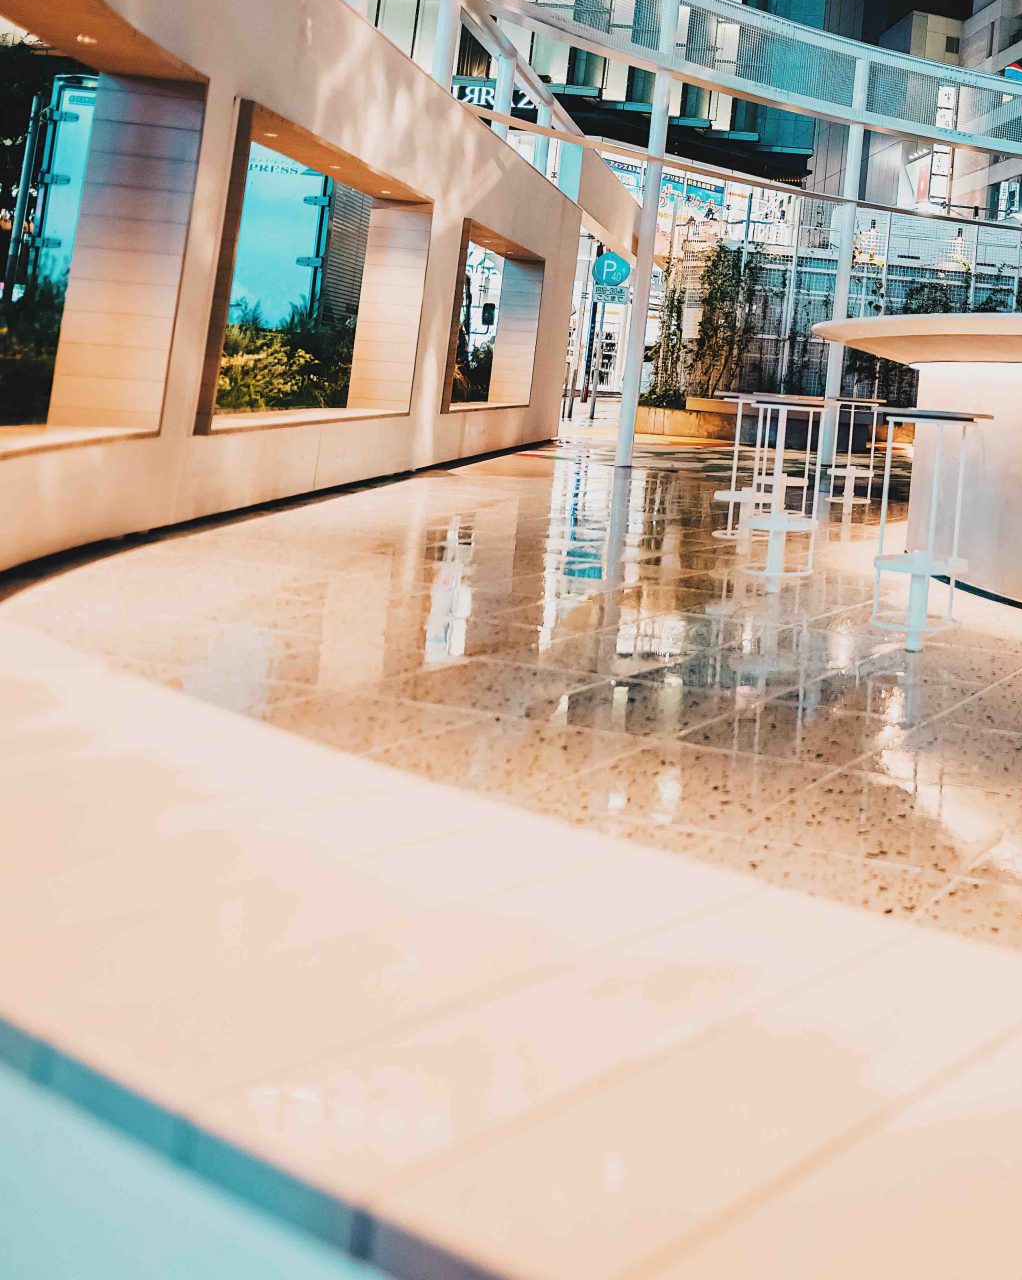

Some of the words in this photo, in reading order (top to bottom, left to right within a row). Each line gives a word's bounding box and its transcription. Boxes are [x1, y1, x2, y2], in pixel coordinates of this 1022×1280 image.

[249, 163, 299, 174] PRESS
[603, 260, 617, 280] P
[596, 294, 624, 303] ここまで
